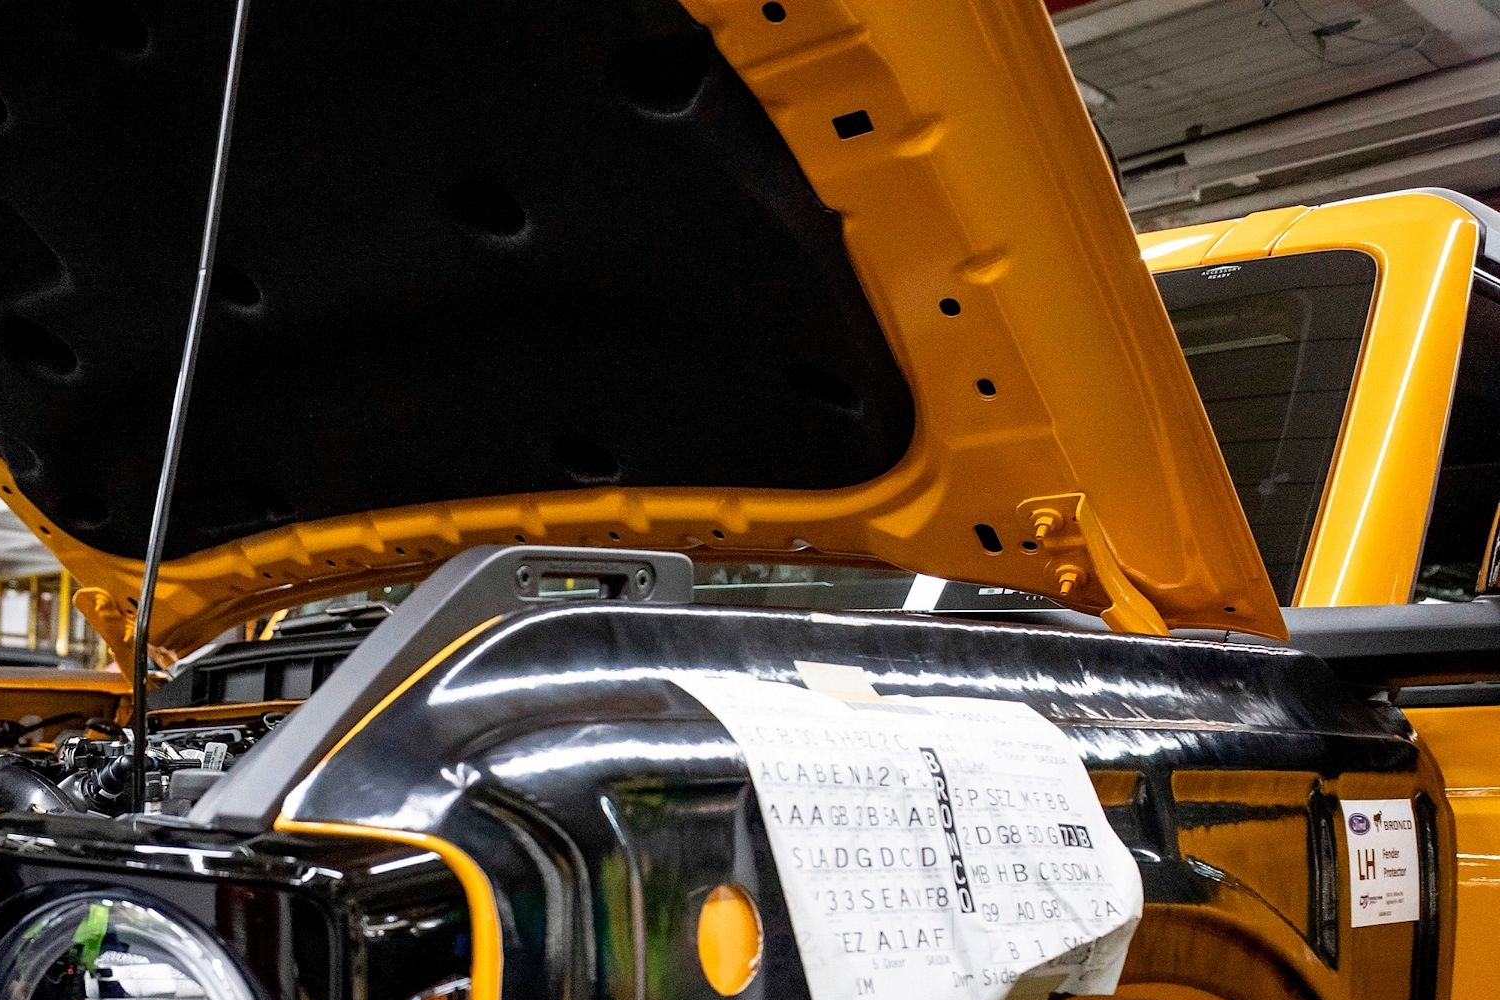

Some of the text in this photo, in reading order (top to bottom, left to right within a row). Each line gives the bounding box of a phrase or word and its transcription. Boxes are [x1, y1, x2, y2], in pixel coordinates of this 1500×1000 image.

[921, 749, 974, 912] BRONCO
[1383, 819, 1412, 831] BRONCO
[1357, 848, 1376, 881] LH
[983, 968, 1018, 987] Side
